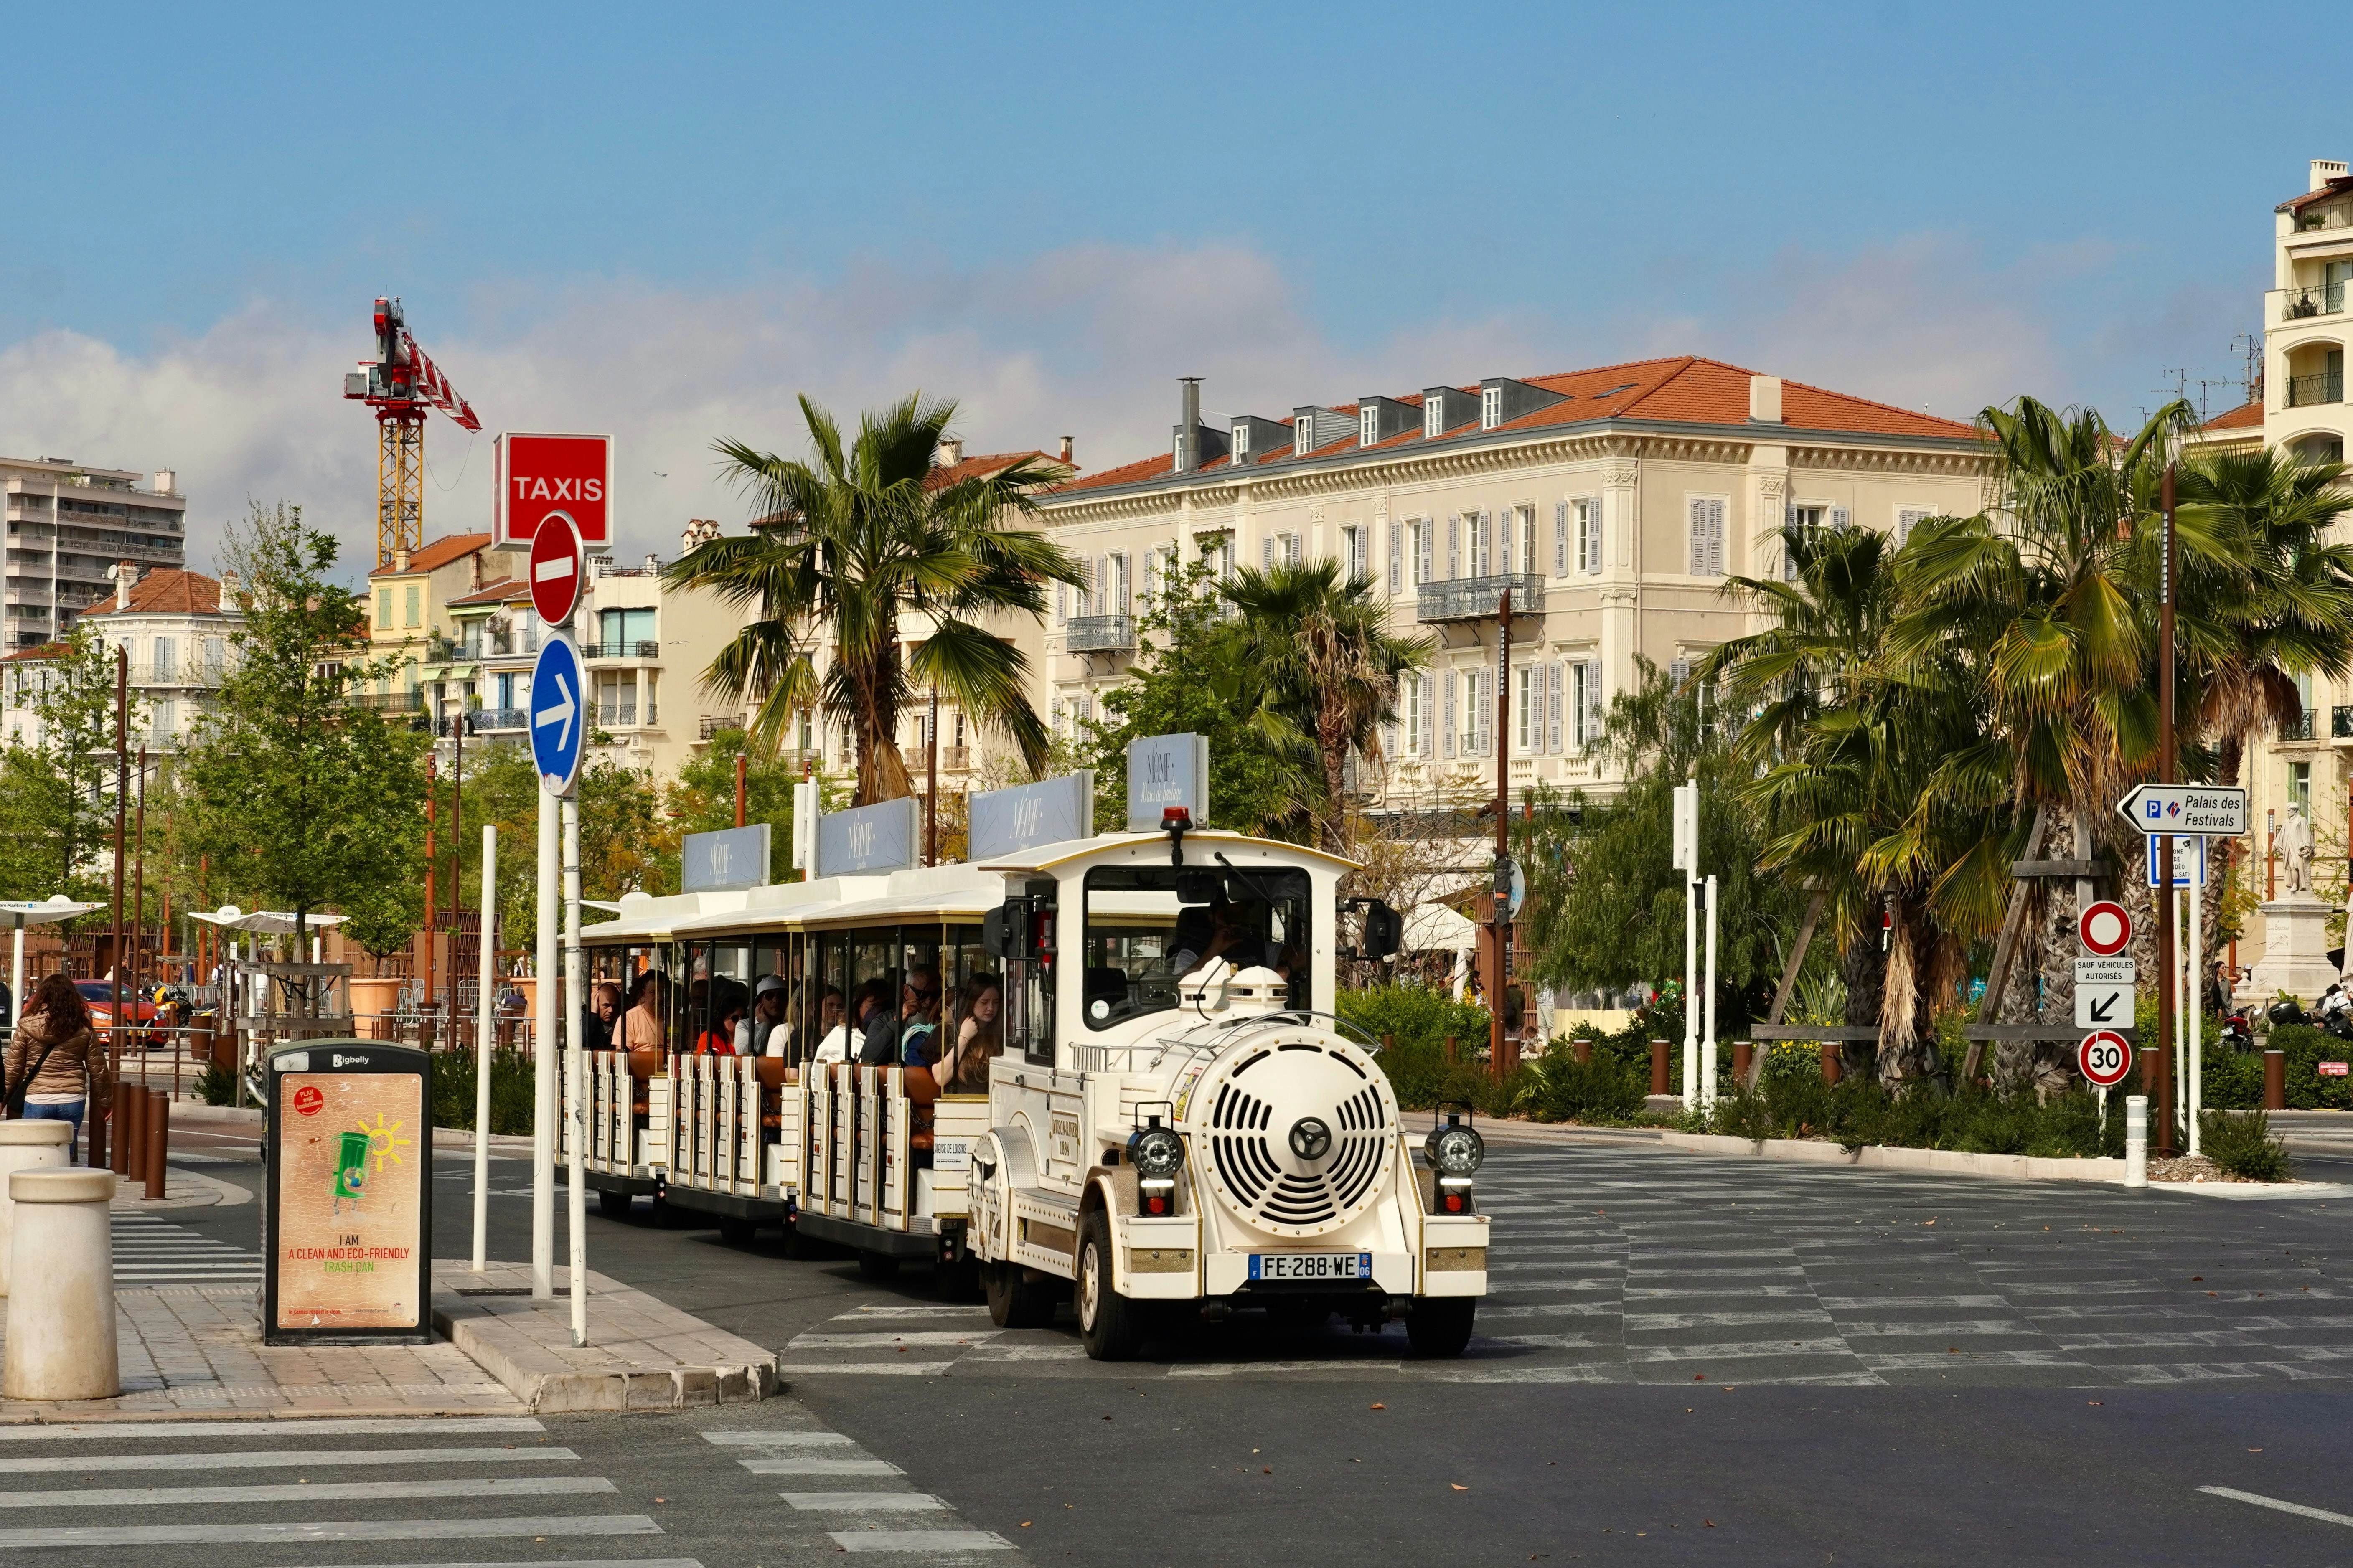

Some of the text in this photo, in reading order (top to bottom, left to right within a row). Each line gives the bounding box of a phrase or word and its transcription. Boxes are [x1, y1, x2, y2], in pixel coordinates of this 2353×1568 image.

[513, 477, 602, 501] TAXIS
[2185, 795, 2218, 809] Palais
[2221, 797, 2240, 809] des
[2185, 813, 2234, 827] Festivals
[333, 1054, 369, 1067] Bigbelly
[2091, 1048, 2120, 1068] 30
[947, 1144, 952, 1154] DE
[953, 1144, 966, 1154] LOISIRS
[1060, 1140, 1069, 1156] 1894
[340, 1235, 359, 1246] I AM
[289, 1248, 409, 1259] A CLEAN AND ECO-FRIENDLY
[324, 1261, 374, 1272] TRASH CAN
[1264, 1257, 1355, 1276] FE-288-WE
[1360, 1267, 1370, 1276] 06
